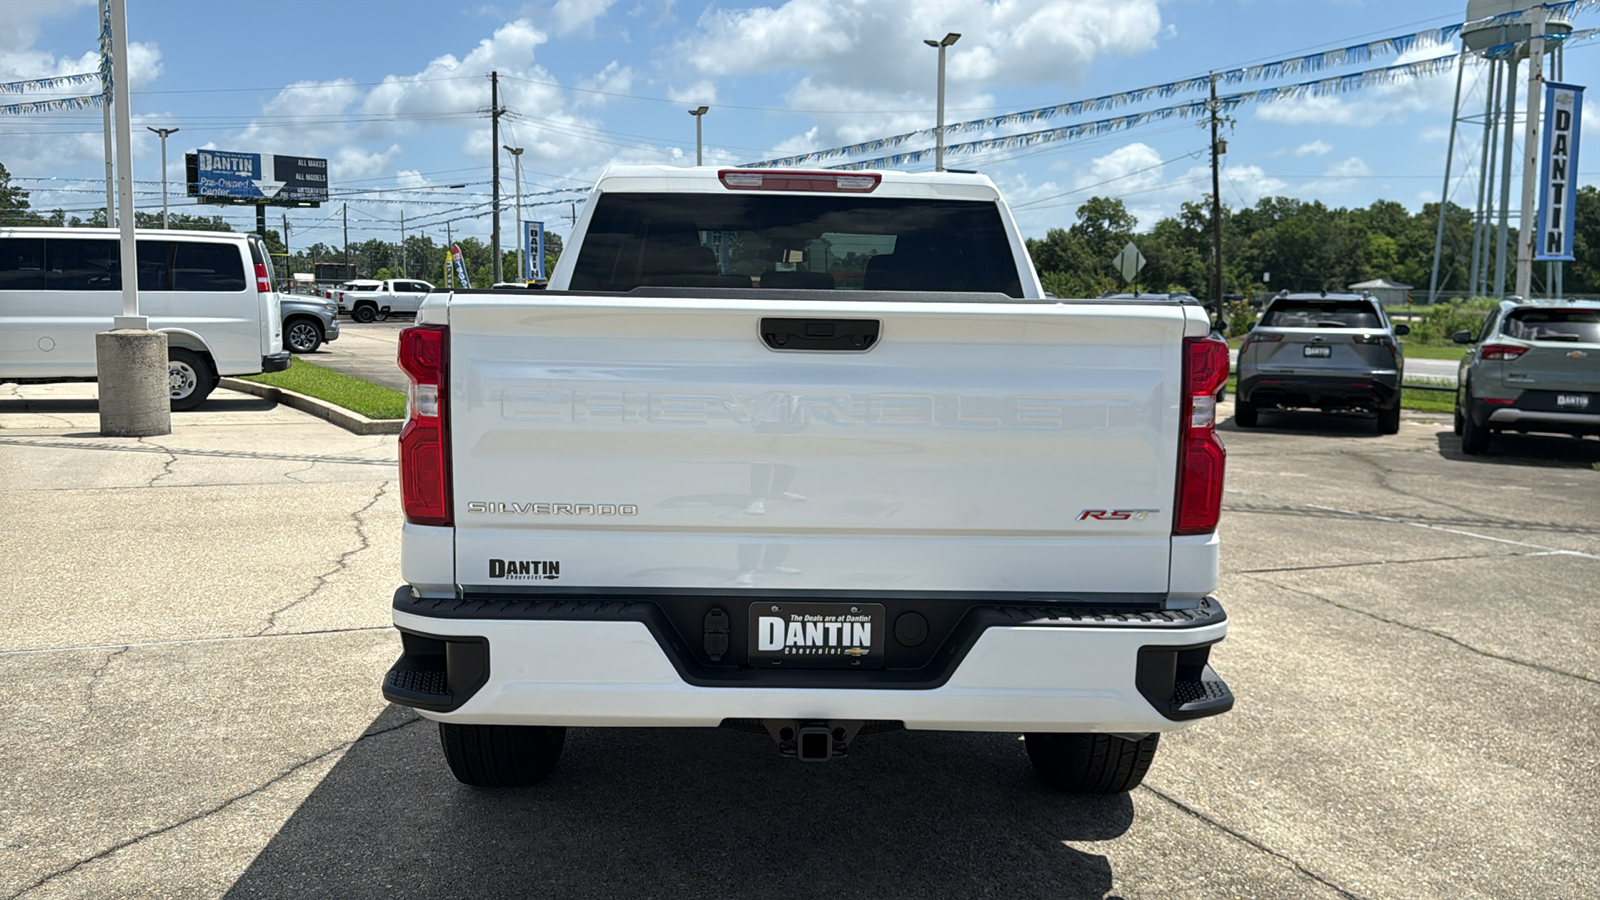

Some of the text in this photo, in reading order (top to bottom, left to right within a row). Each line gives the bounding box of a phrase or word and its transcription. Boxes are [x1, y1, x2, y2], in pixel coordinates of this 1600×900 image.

[199, 152, 253, 172] DANTIN
[298, 159, 326, 168] ALL MAKES
[200, 177, 249, 188] Pre-Owned
[295, 172, 326, 182] ALL MODELS
[1547, 109, 1571, 253] DANTIN
[200, 186, 230, 196] Center
[530, 229, 539, 278] DANTIN
[500, 386, 1134, 431] CHEVROLET
[467, 501, 639, 517] SILVERADO
[1075, 508, 1160, 521] RST
[488, 558, 560, 579] DANTIN
[804, 614, 823, 622] Deals
[758, 616, 871, 651] DANTIN
[784, 647, 841, 655] Chevrolet
